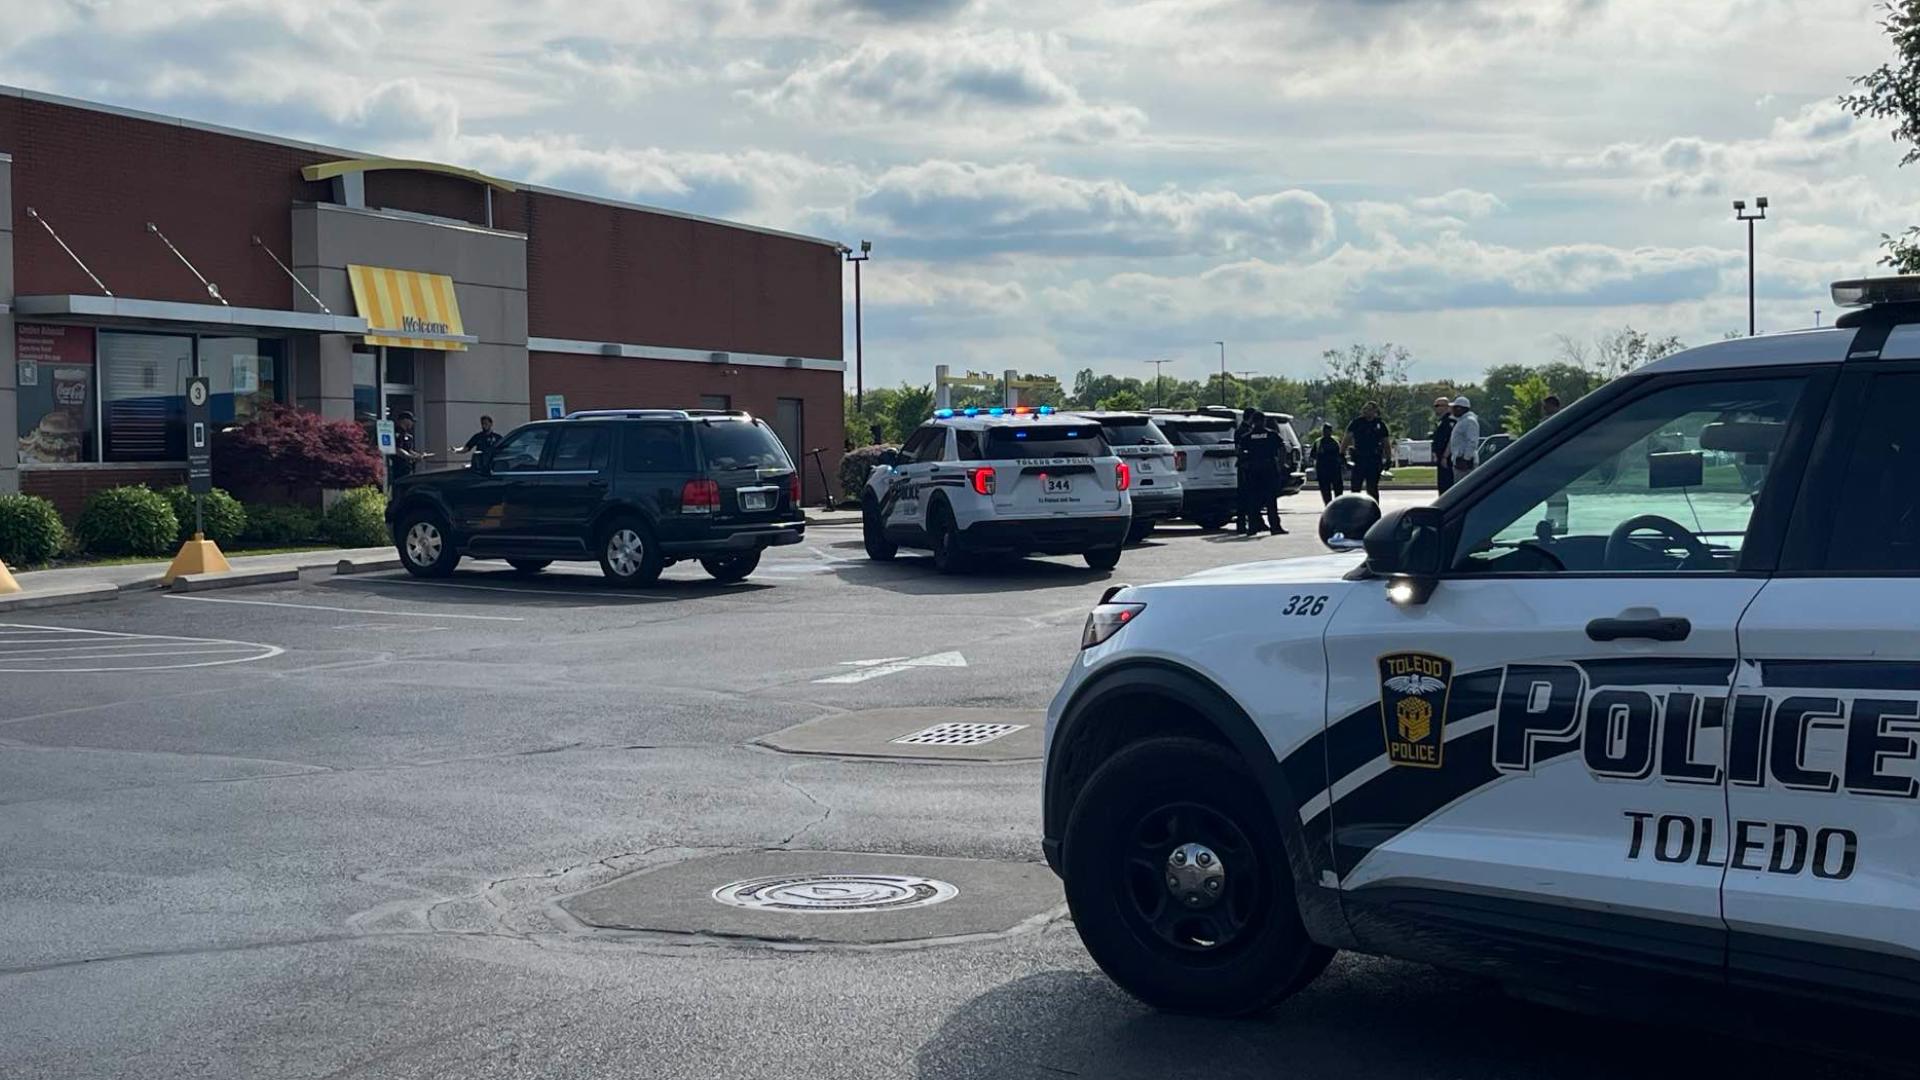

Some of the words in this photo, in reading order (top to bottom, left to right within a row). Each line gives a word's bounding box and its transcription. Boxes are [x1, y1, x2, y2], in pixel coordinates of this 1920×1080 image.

[402, 315, 448, 334] Welcome
[195, 387, 202, 399] 3
[1048, 480, 1070, 490] 344
[1282, 595, 1329, 616] 326
[1387, 655, 1443, 677] TOLEDO
[1493, 662, 1920, 799] POLICE
[1391, 742, 1436, 762] POLICE
[1623, 810, 1859, 881] TOLEDO
